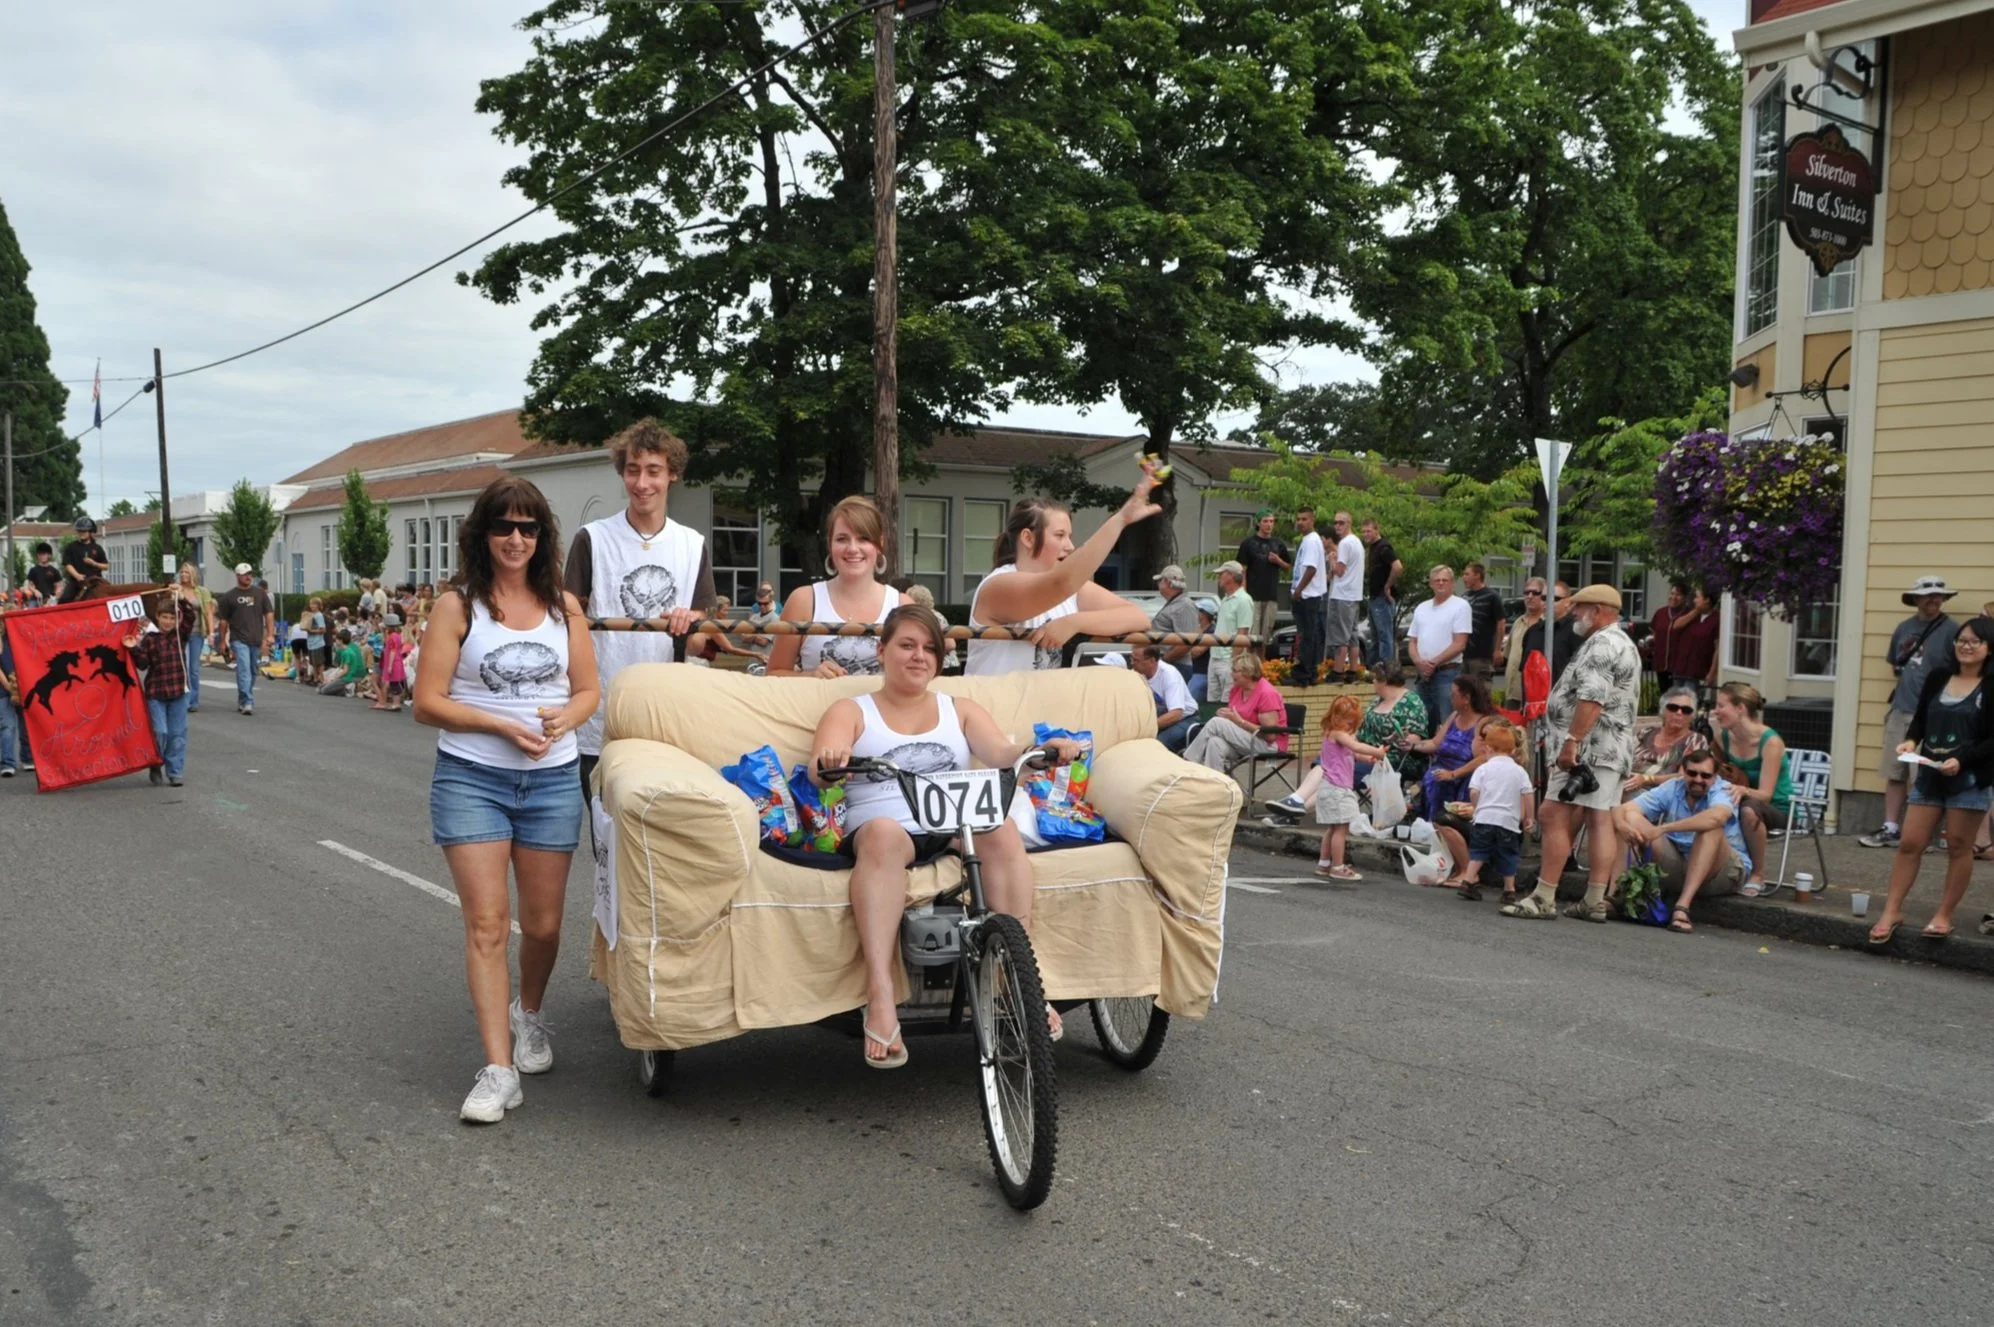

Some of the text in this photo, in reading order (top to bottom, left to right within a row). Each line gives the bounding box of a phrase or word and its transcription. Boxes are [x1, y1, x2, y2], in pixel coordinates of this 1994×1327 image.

[1805, 154, 1857, 188] Silverton
[1792, 183, 1867, 225] Inn & Suites
[112, 600, 141, 620] 010
[924, 778, 998, 827] 074
